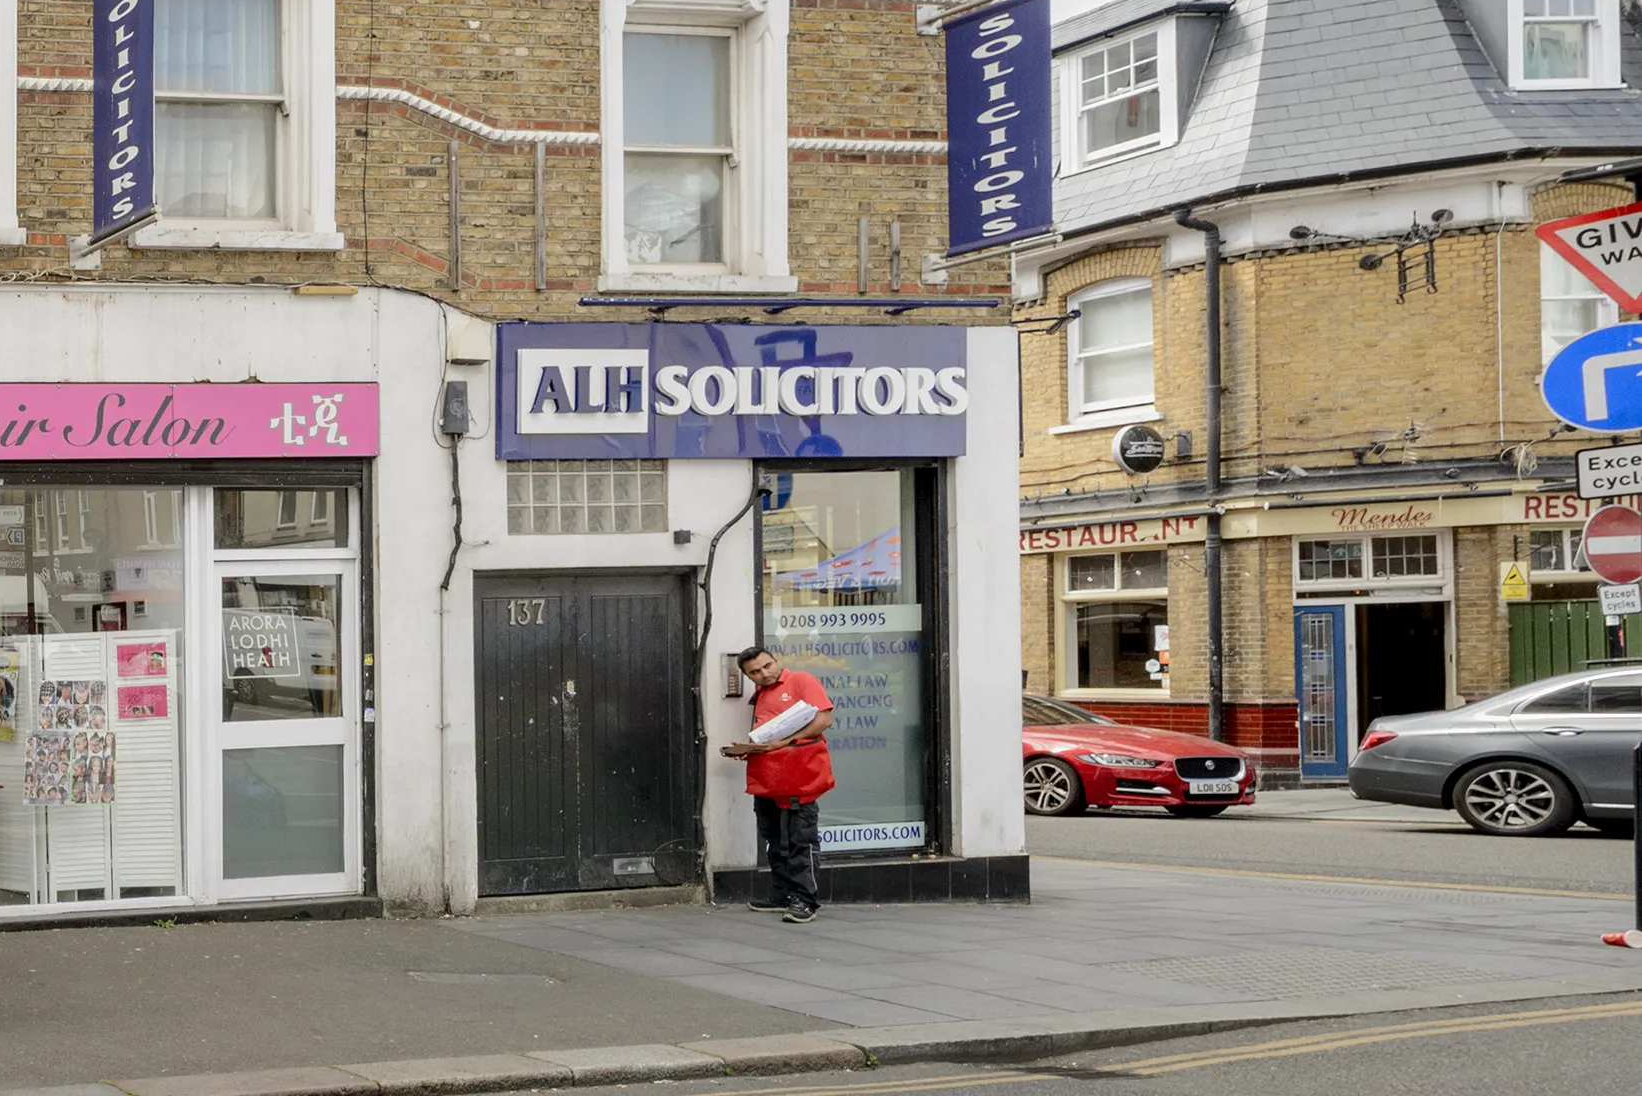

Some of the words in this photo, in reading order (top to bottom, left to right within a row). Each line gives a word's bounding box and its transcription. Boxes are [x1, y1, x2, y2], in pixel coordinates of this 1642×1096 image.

[971, 12, 1025, 238] SOLICITORS
[1576, 216, 1642, 249] GIV
[1600, 246, 1642, 266] WA
[529, 365, 646, 414] ALH
[654, 365, 969, 417] SOLICITORS
[62, 392, 237, 448] Salon
[1588, 455, 1642, 471] Exce
[1592, 471, 1642, 490] cycl
[1331, 504, 1434, 526] Mendes
[1019, 516, 1201, 551] RESTAURNT
[1603, 589, 1637, 600] Except
[507, 599, 545, 625] 137
[1607, 599, 1637, 611] cycles
[229, 615, 287, 631] ARORA
[779, 614, 817, 629] 0208
[820, 613, 847, 627] 993
[850, 612, 886, 626] 9995
[230, 633, 289, 650] LODHI
[233, 652, 290, 668] HEATH
[857, 674, 889, 689] LAW
[817, 825, 921, 843] SOLICITORS.COM
